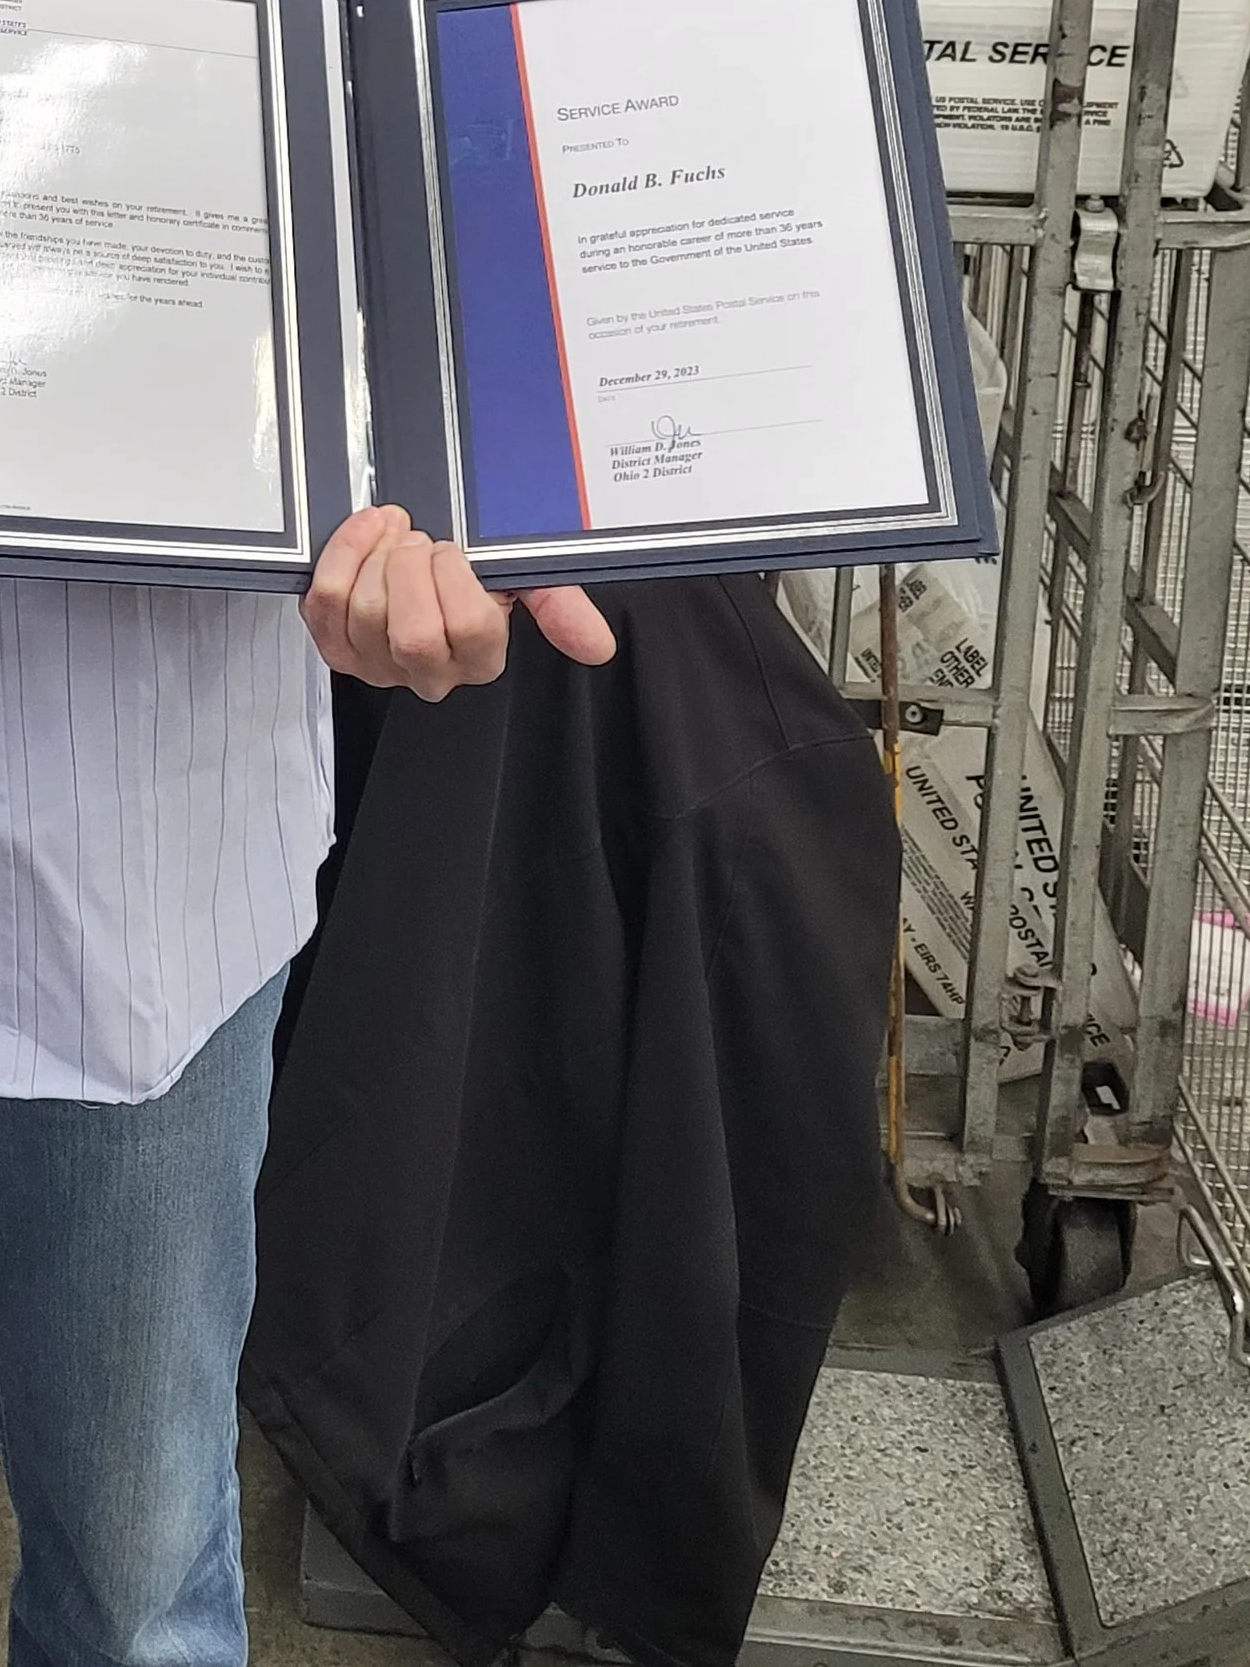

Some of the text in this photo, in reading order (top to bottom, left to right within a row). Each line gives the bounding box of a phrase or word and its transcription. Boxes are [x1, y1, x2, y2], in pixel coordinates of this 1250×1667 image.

[988, 41, 1130, 67] SERCE
[557, 95, 679, 122] SERVICE AWARD
[962, 106, 998, 114] FEDERAL
[1020, 99, 1036, 107] USE
[573, 165, 726, 198] Donald B. Fuchs
[23, 202, 220, 229] present honorary certificate
[51, 215, 72, 224] years
[62, 196, 78, 204] best
[204, 211, 224, 220] gives
[590, 209, 794, 244] grateful appreciation for dedicated service
[20, 232, 63, 244] friendships
[131, 244, 148, 253] your
[151, 246, 184, 256] devotion
[580, 220, 823, 259] during an honorable career of more than 36 years
[154, 258, 197, 267] satisfaction
[582, 241, 777, 273] service to the Government of the United
[201, 272, 237, 281] individual
[154, 297, 176, 305] years
[586, 291, 820, 326] Given by the United Service on this
[634, 323, 667, 334] of your
[599, 365, 699, 387] December 29, 2023
[610, 439, 701, 457] William D. Jones
[612, 452, 703, 470] District Manager
[614, 465, 692, 482] Ohio 2 District
[940, 650, 975, 688] OTHER
[955, 638, 989, 677] LABEL
[905, 765, 958, 831] UNITED
[914, 942, 941, 974] EIRS
